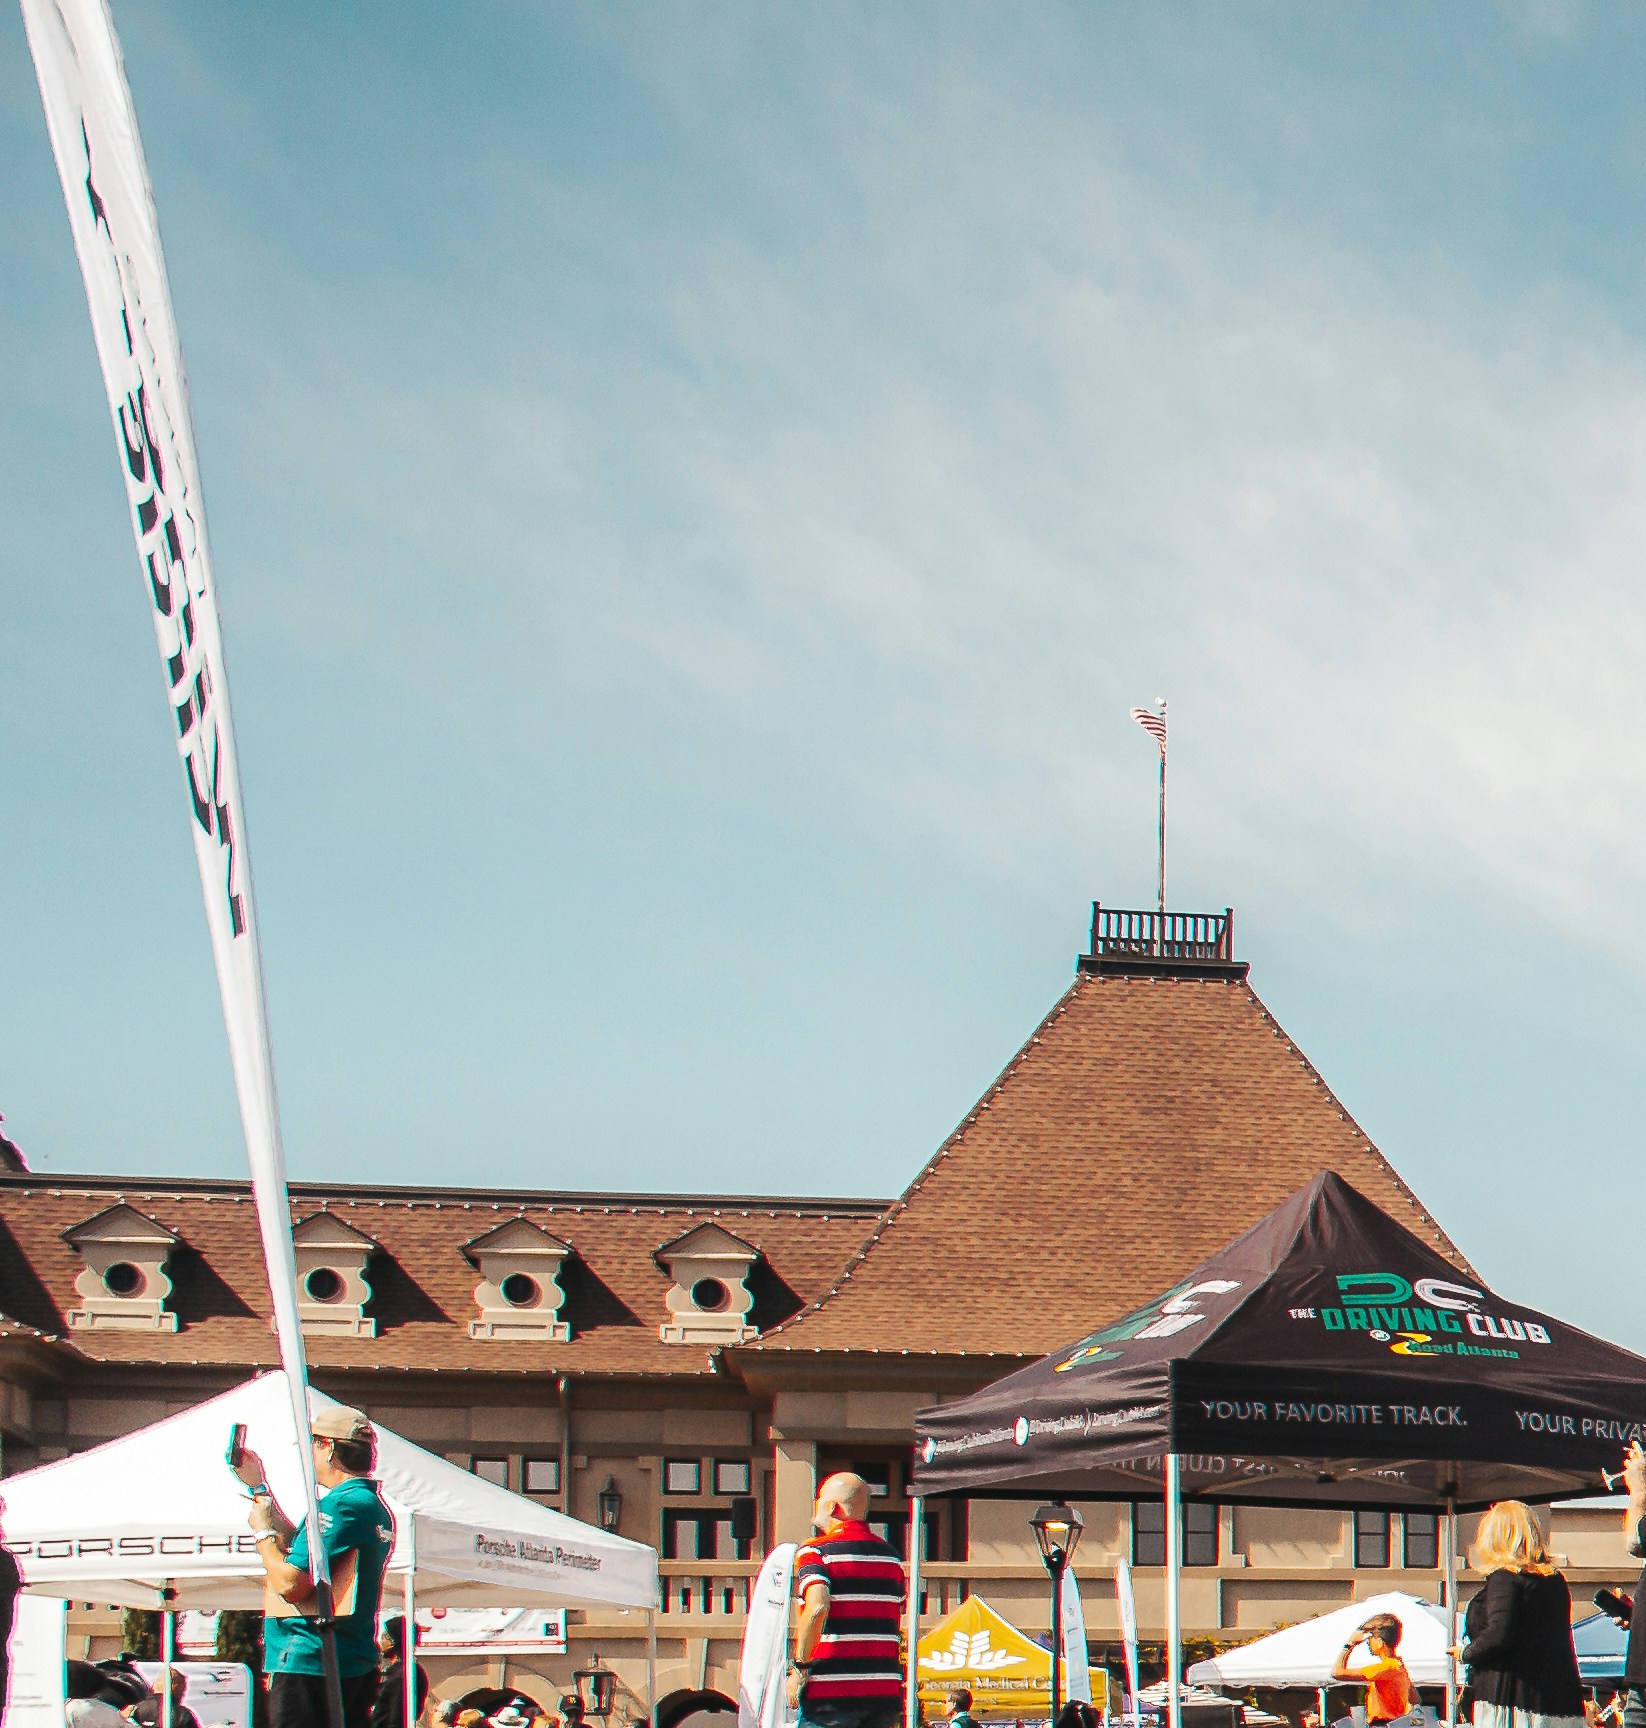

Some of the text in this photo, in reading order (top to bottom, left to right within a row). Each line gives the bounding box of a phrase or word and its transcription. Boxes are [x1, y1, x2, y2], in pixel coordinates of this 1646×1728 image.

[1288, 1306, 1552, 1344] THE DRIVING CLUB
[1408, 1339, 1520, 1359] Road Atlanta
[1200, 1400, 1469, 1426] YOUR FAVORITE TRACK.
[1514, 1411, 1577, 1436] YOUR
[975, 1675, 1029, 1691] Medical
